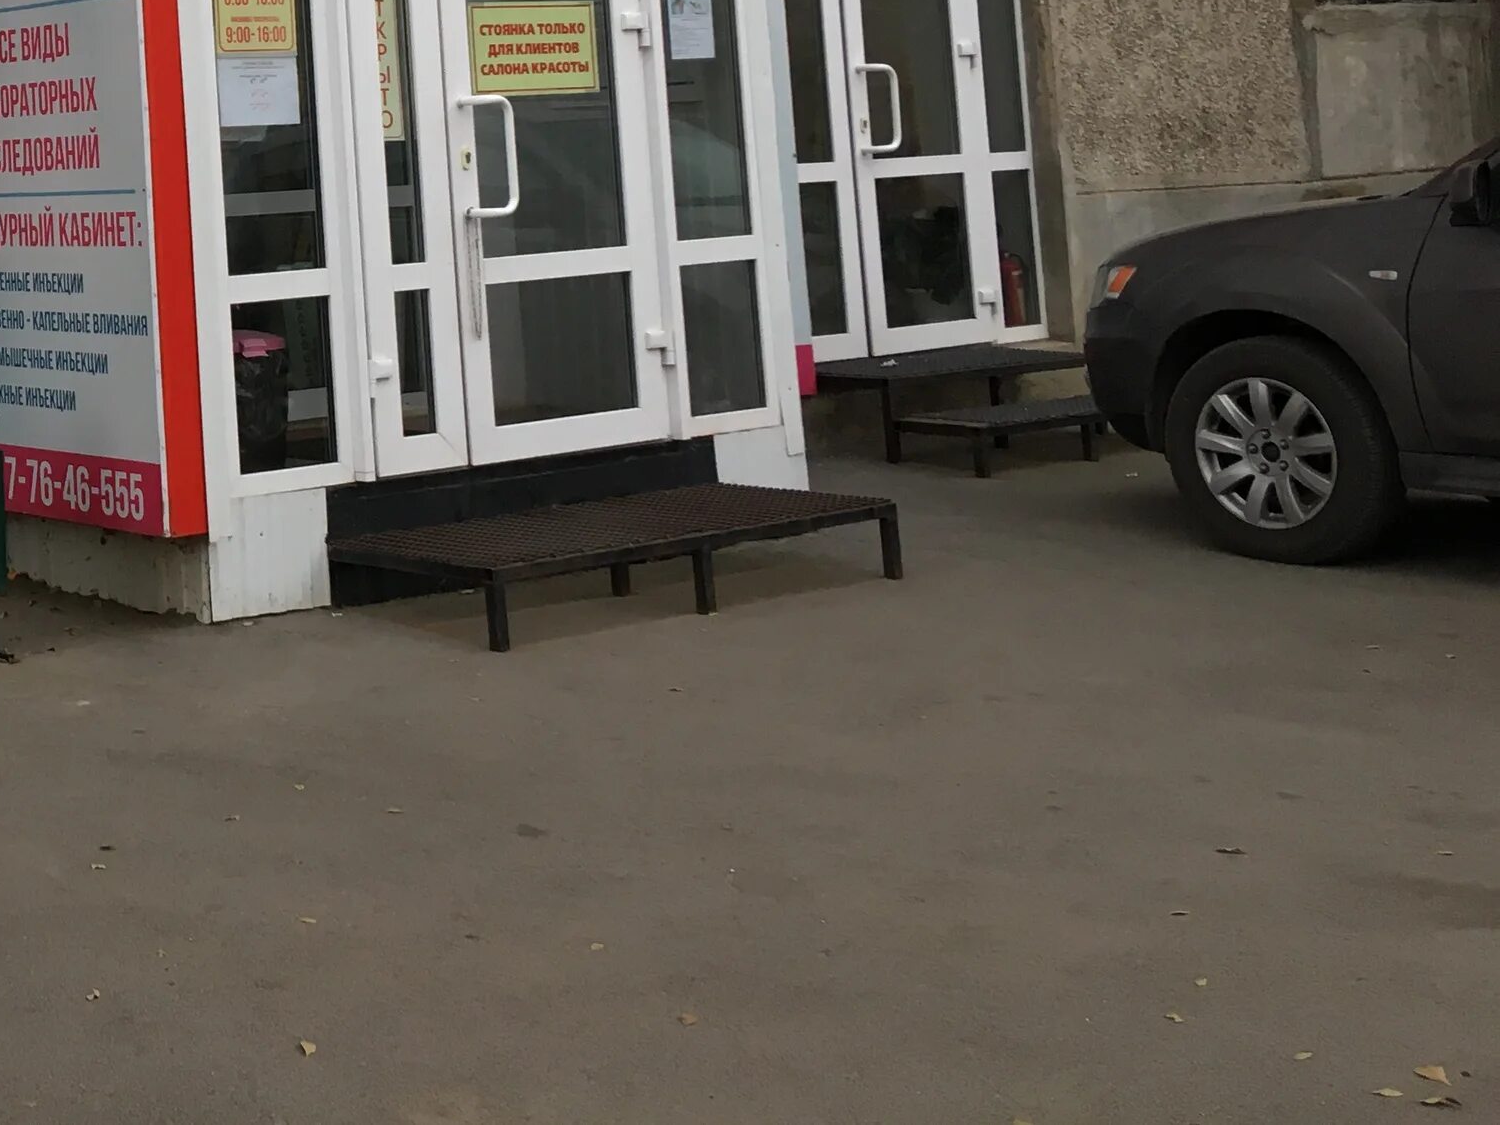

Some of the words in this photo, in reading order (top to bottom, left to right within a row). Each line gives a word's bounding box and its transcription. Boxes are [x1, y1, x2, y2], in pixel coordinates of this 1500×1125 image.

[479, 23, 536, 36] СТОЯНКА
[537, 22, 586, 35] ТОЛЬКО
[21, 22, 70, 63] ВИДЫ
[488, 43, 514, 58] ДЛЯ
[515, 42, 580, 55] КЛИЕНТОВ
[480, 62, 530, 76] САЛОНА
[531, 61, 590, 74] КРАСОТЫ
[59, 211, 143, 248] КАБИНЕТ:
[32, 273, 84, 295] ИНЪЕКЦИИ
[32, 310, 91, 334] КАПЕЛЬНЫЕ
[92, 314, 149, 337] ВЛИВАНИЯ
[55, 350, 109, 375] ИНЪЕКЦИИ
[25, 386, 77, 412] ИНЪЕКЦИИ
